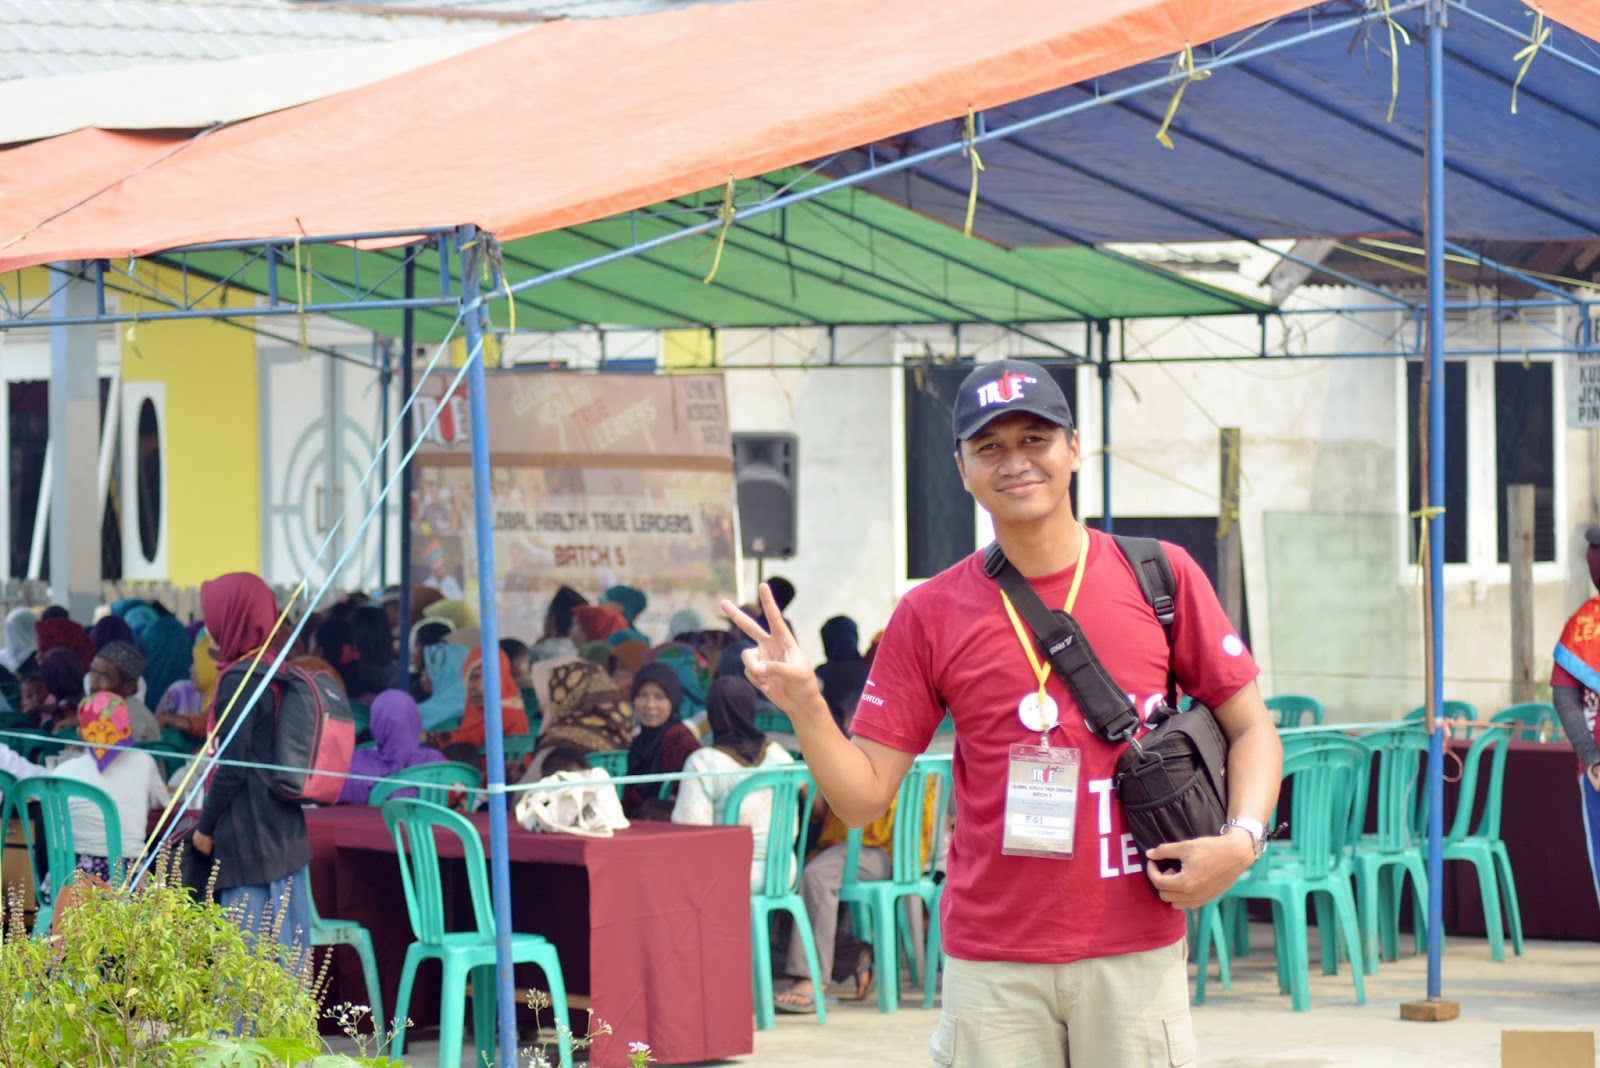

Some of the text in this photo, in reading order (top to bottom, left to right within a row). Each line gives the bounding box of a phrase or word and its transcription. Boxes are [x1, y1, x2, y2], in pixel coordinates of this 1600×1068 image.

[977, 376, 1024, 407] TRUE
[536, 512, 588, 531] HEALTH
[592, 512, 629, 532] TRUE
[631, 512, 694, 534] LEADERS
[553, 545, 611, 567] BATCH
[1032, 767, 1056, 783] TRUE
